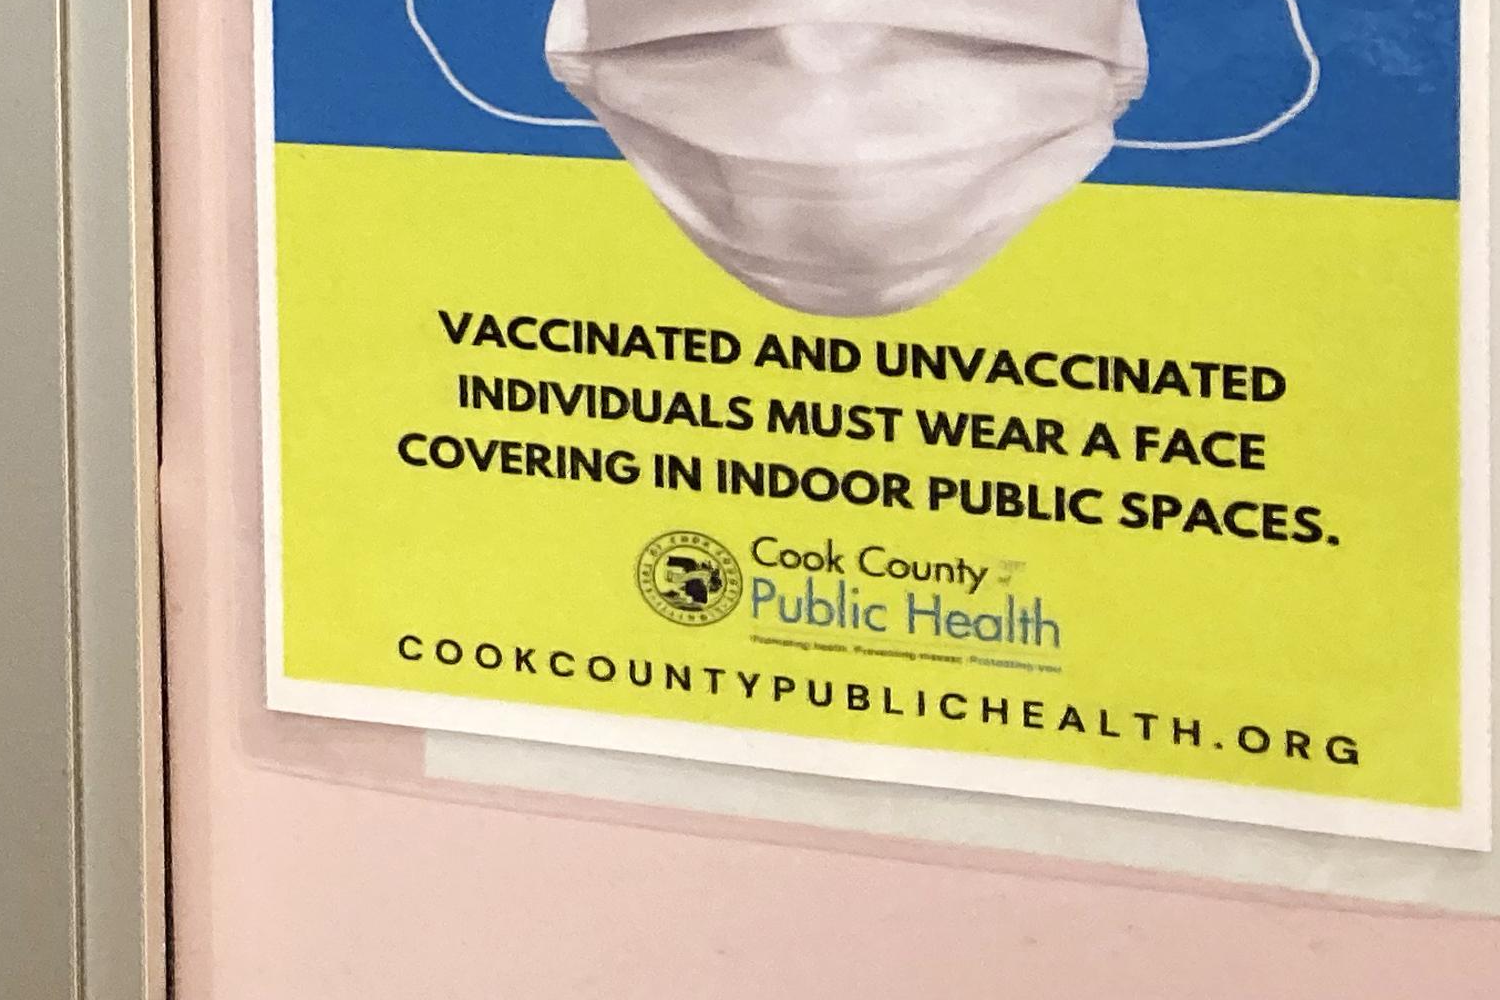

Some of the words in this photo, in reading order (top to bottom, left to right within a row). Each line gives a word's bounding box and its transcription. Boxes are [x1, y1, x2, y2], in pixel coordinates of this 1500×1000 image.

[437, 310, 742, 365] VACCINATED
[753, 333, 862, 374] AND
[876, 340, 1287, 402] UNVACCINATED
[458, 374, 754, 431] INDIVIDUALS
[767, 398, 903, 443] MUST
[916, 409, 1069, 456] WEAR
[1081, 422, 1121, 460] A
[1135, 425, 1266, 471] FACE
[397, 432, 641, 486] COVERING
[654, 453, 702, 492] IN
[717, 458, 914, 510] INDOOR
[928, 475, 1104, 525] PUBLIC
[1118, 491, 1340, 547] SPACES.
[750, 576, 887, 632] Public
[907, 592, 1061, 648] Health
[751, 536, 845, 575] Cook
[858, 545, 989, 595] County
[398, 635, 1360, 766] COOKCOUNTYPUBLICHEALTH.ORG
